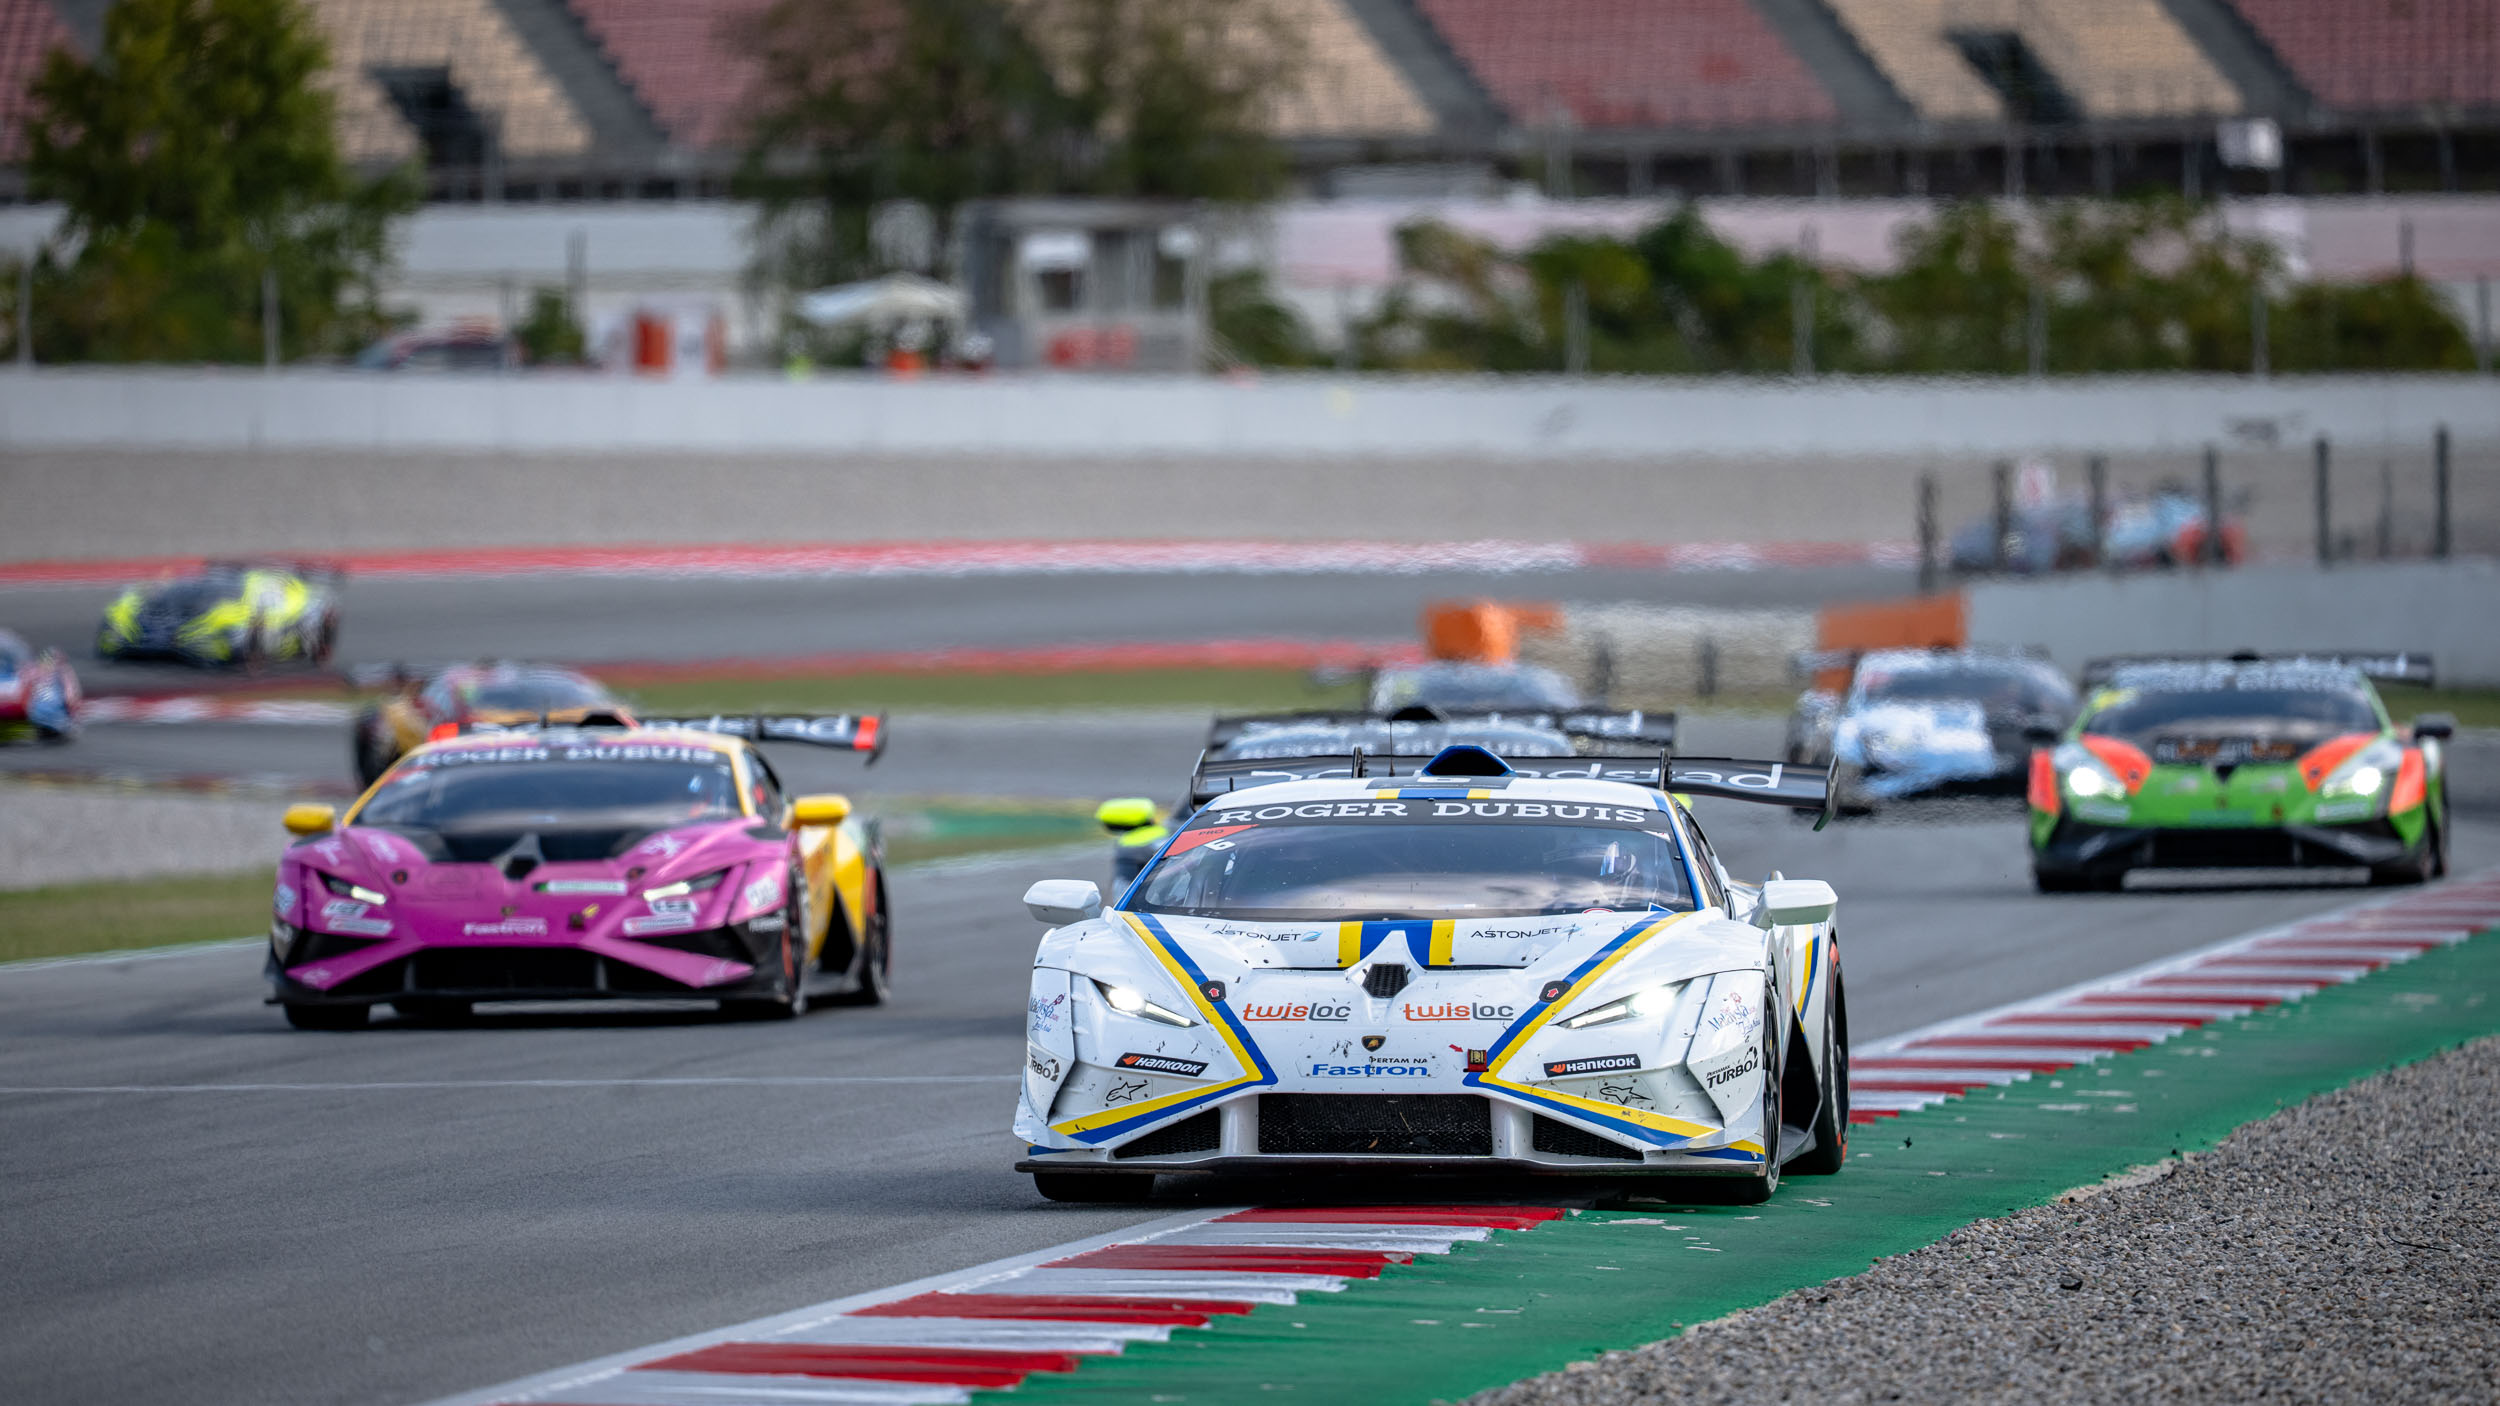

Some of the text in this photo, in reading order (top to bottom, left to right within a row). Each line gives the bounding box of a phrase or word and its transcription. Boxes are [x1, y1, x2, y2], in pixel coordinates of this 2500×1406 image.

[1213, 802, 1646, 825] ROGER DUBUIS
[1198, 828, 1225, 836] PRO
[1204, 838, 1236, 851] 6
[1211, 929, 1302, 942] ASTONJET
[1471, 926, 1562, 939] ASTONJET
[1243, 1002, 1352, 1021] twisloc
[1403, 1002, 1514, 1021] twisloc
[1312, 1063, 1428, 1076] Fastron
[1706, 1060, 1753, 1089] TURBO
